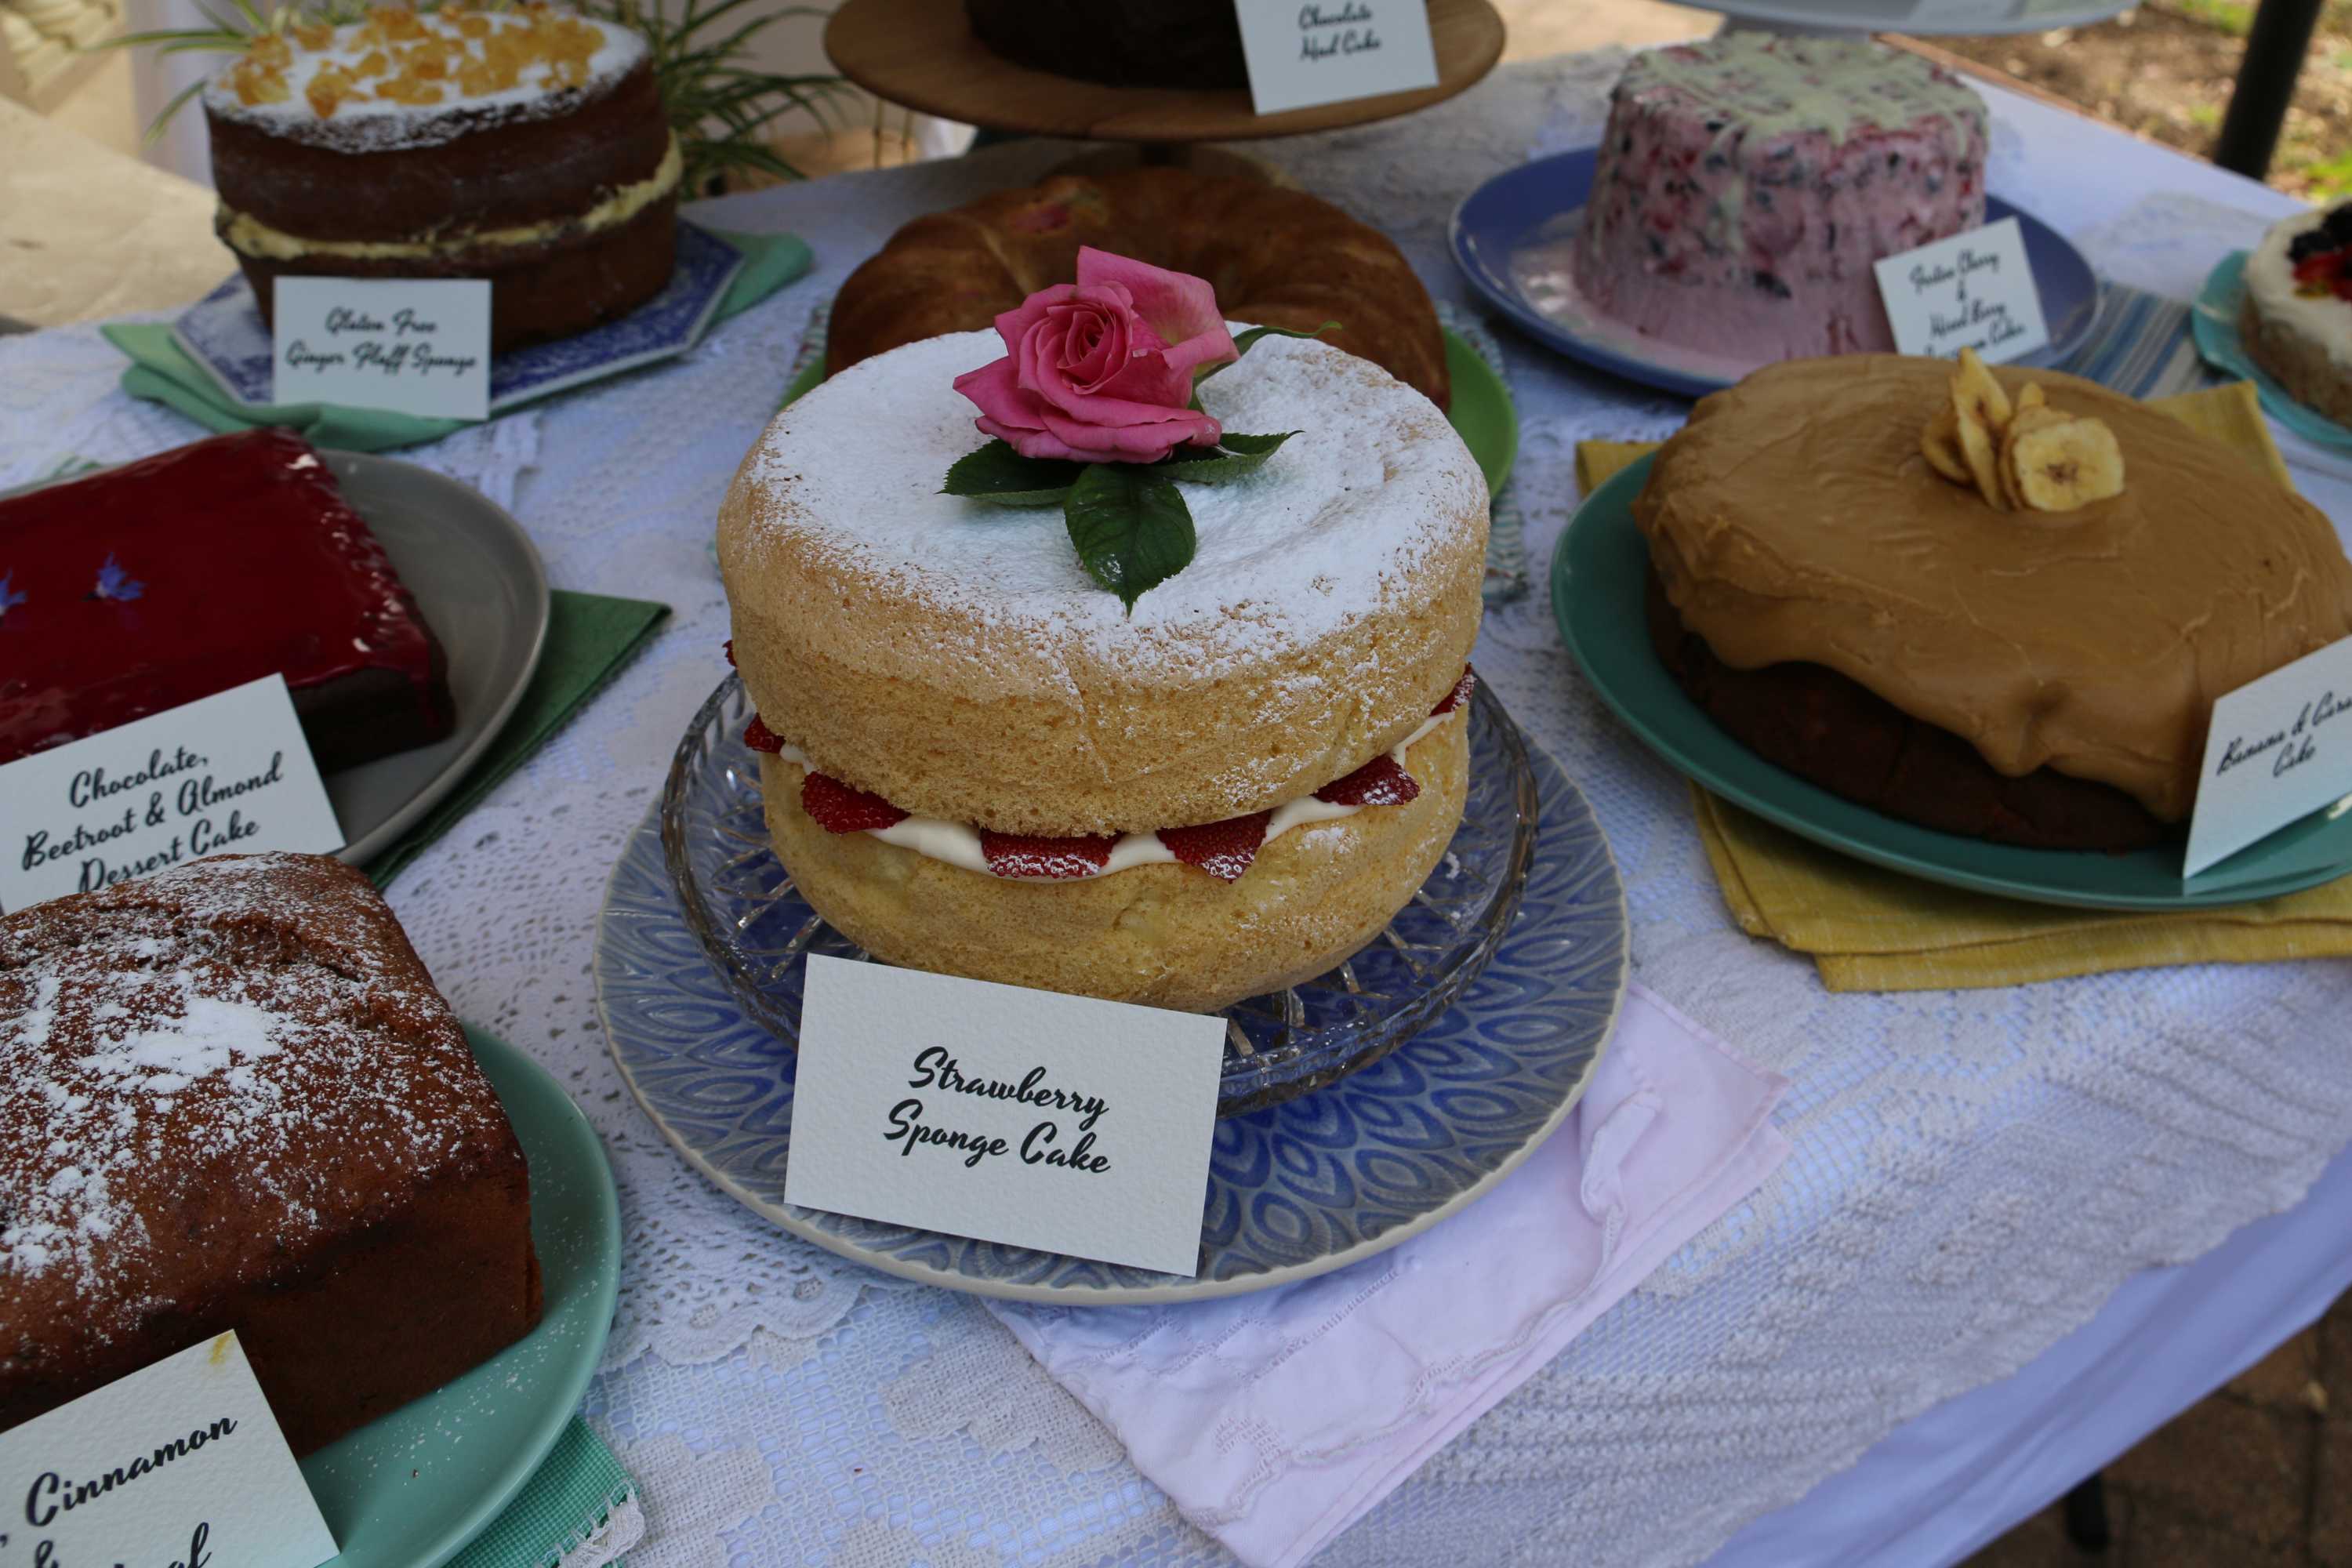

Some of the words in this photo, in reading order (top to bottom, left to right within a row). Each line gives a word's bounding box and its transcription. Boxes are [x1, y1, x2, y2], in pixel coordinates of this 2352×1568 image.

[1341, 28, 1381, 56] Cake
[325, 307, 384, 334] Gluten
[392, 307, 437, 336] Free
[285, 339, 345, 373] Ginger
[352, 342, 410, 376] Fluff
[411, 342, 476, 376] Sponge
[69, 745, 208, 808] Chocolate,
[2216, 731, 2286, 776] Banana
[2273, 733, 2317, 778] Cake
[21, 808, 137, 872] Beetroot
[144, 792, 166, 828] &
[177, 751, 284, 816] Almond
[80, 836, 184, 892] Dessert
[190, 810, 261, 856] Cake
[909, 1046, 1109, 1131] Strawberry
[883, 1098, 1008, 1168] Sponge
[1020, 1122, 1112, 1174] Cake
[25, 1417, 238, 1527] Cinnamon
